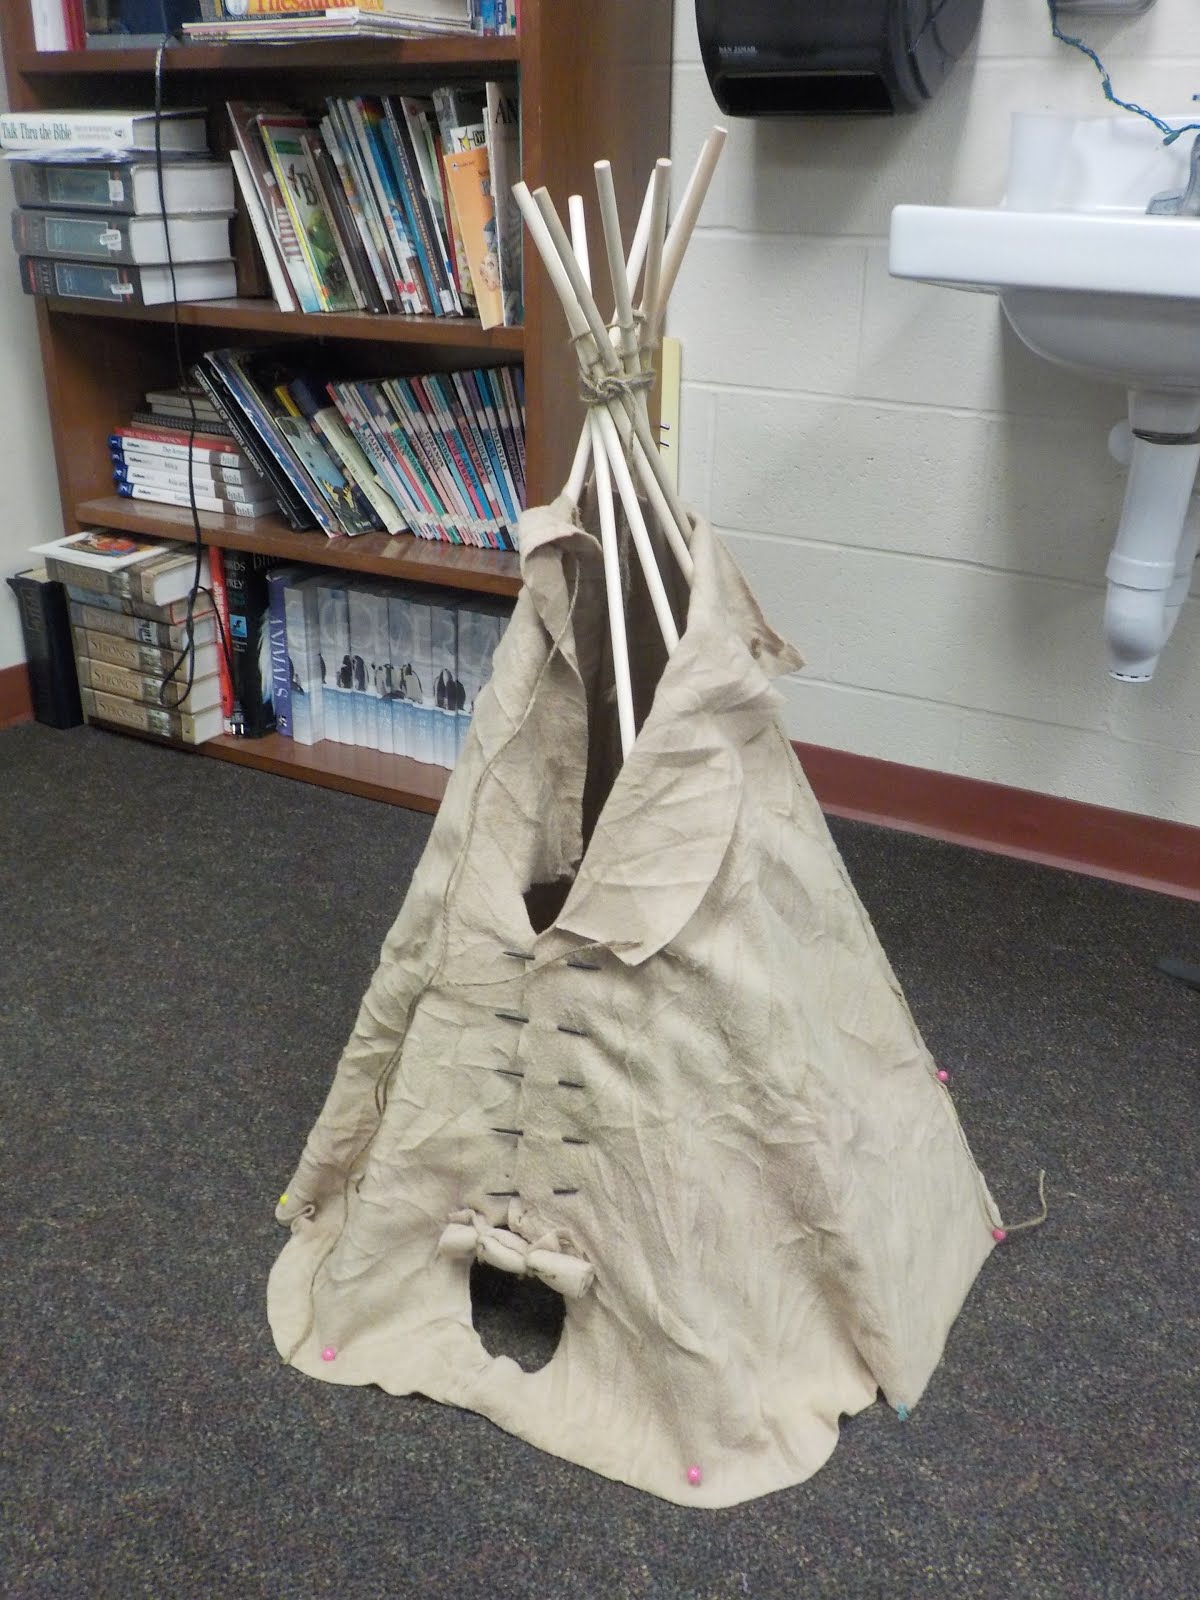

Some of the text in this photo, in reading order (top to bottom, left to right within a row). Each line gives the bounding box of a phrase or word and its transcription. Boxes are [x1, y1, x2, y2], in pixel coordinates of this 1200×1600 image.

[1, 122, 18, 140] Talk
[20, 122, 38, 140] Thru
[39, 122, 52, 140] the
[53, 122, 72, 140] Bible
[366, 432, 386, 462] TAIWAN
[424, 430, 445, 467] LEBANON
[471, 427, 493, 475] HONDURAS
[491, 427, 508, 470] PAKISTAN
[269, 619, 287, 698] ANIMALS
